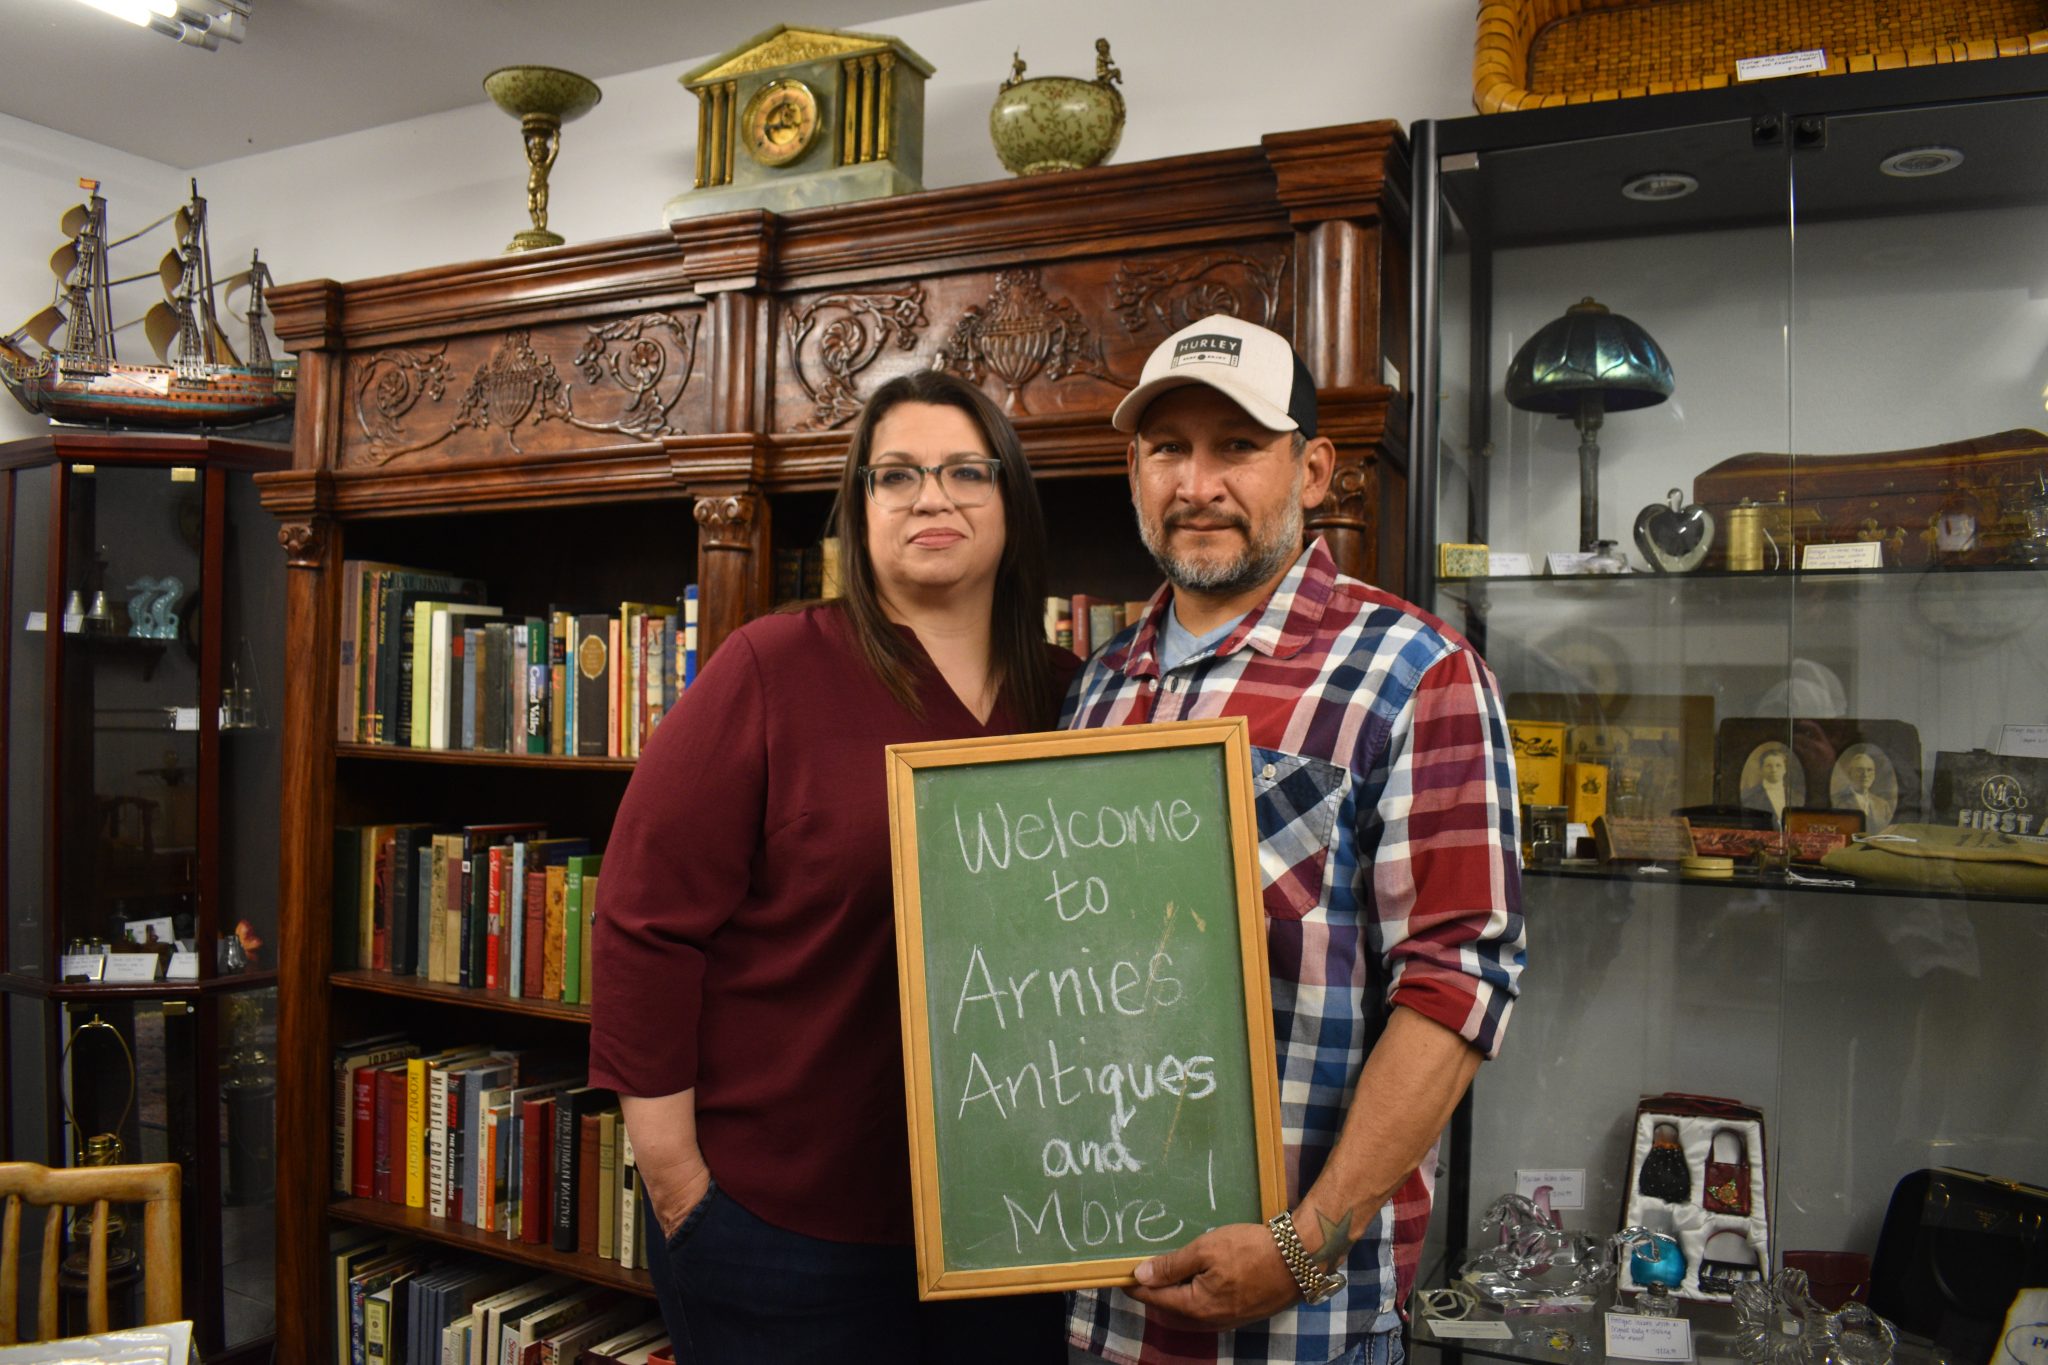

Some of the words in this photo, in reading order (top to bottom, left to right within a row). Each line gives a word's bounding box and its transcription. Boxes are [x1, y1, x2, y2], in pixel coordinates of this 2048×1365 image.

[1180, 339, 1237, 352] HURLEY
[527, 705, 540, 736] Valley
[953, 798, 1200, 874] Welcome
[1958, 809, 2033, 833] FIRST
[1045, 869, 1109, 922] to
[410, 1076, 420, 1123] KOONTZ
[431, 1076, 443, 1131] MICHAEL
[959, 1036, 1217, 1128] Antiques
[562, 1108, 572, 1134] THE
[1042, 1113, 1142, 1177] and
[410, 1126, 419, 1178] VELOCITY
[431, 1141, 443, 1206] CRICHTON
[561, 1135, 572, 1179] HUMAN
[560, 1181, 571, 1228] FACTOR
